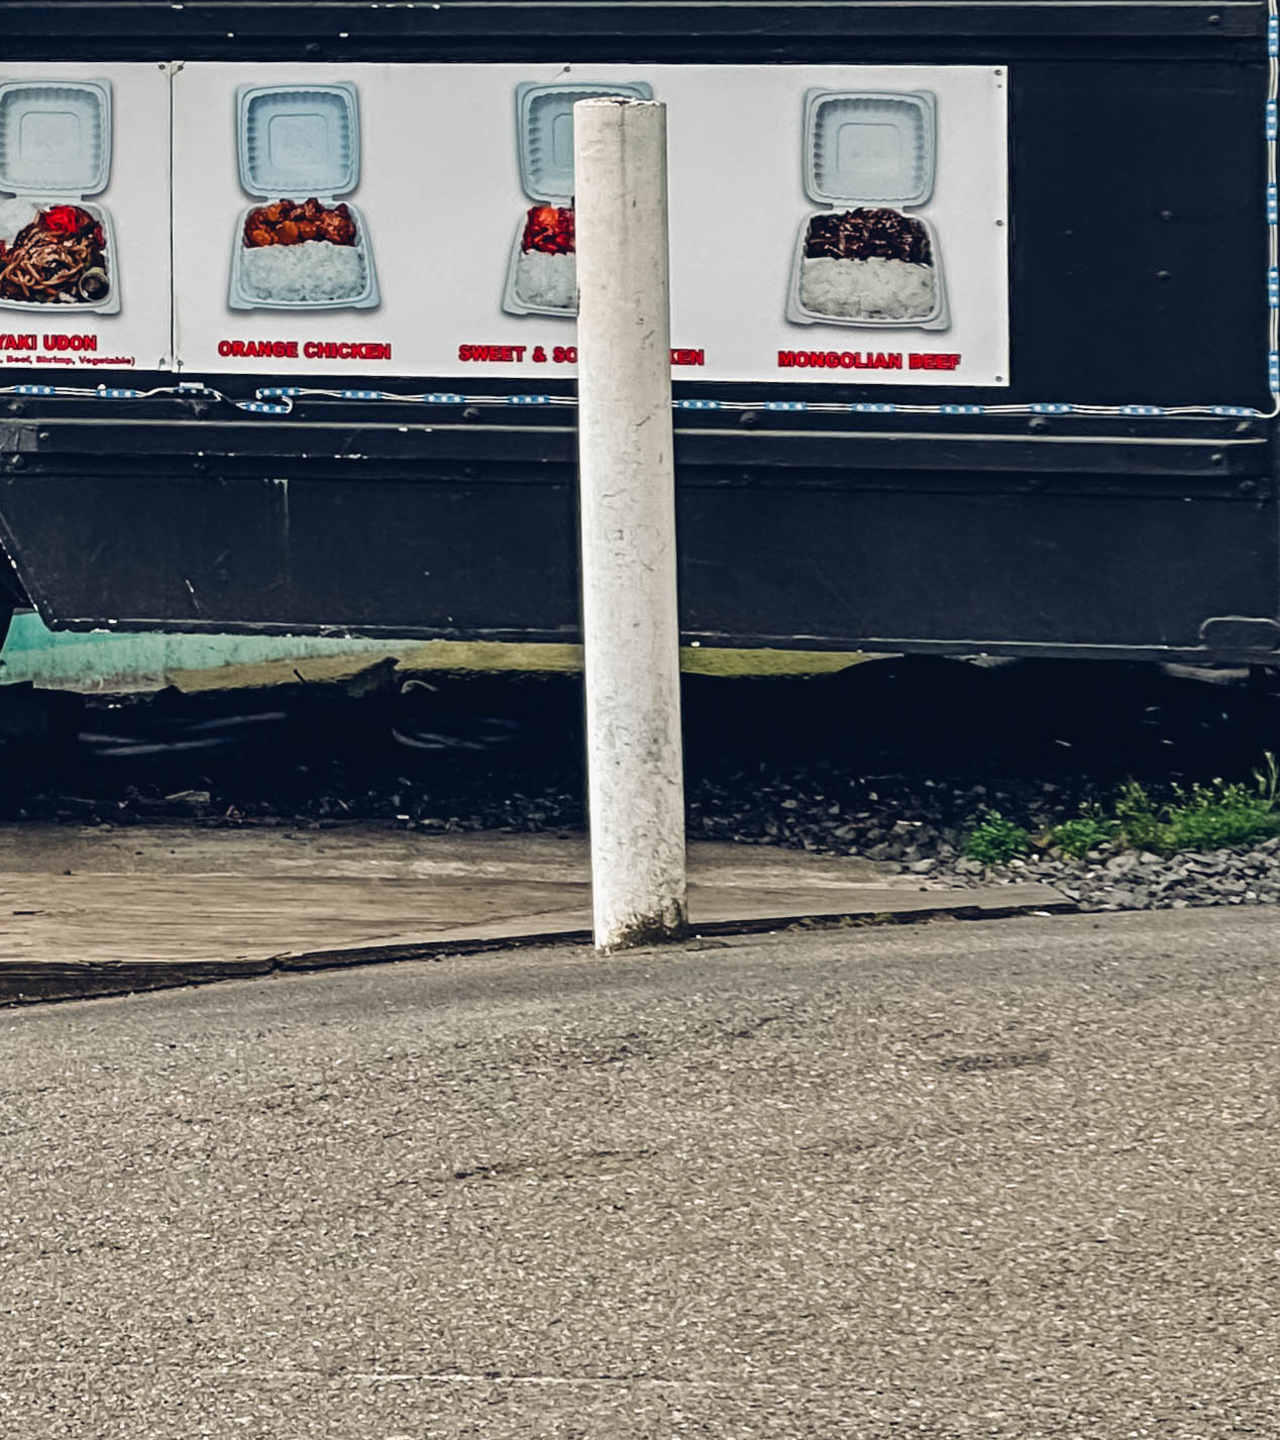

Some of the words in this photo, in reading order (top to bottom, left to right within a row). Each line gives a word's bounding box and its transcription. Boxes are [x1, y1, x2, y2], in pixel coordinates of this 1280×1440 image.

[42, 334, 98, 352] UDON
[218, 340, 298, 359] ORANGE
[304, 341, 391, 360] CHICKEN
[458, 344, 526, 362] SWEET
[531, 345, 547, 363] &
[552, 346, 578, 363] SO
[777, 350, 903, 370] MONGOLIAN
[909, 352, 962, 371] BEEF
